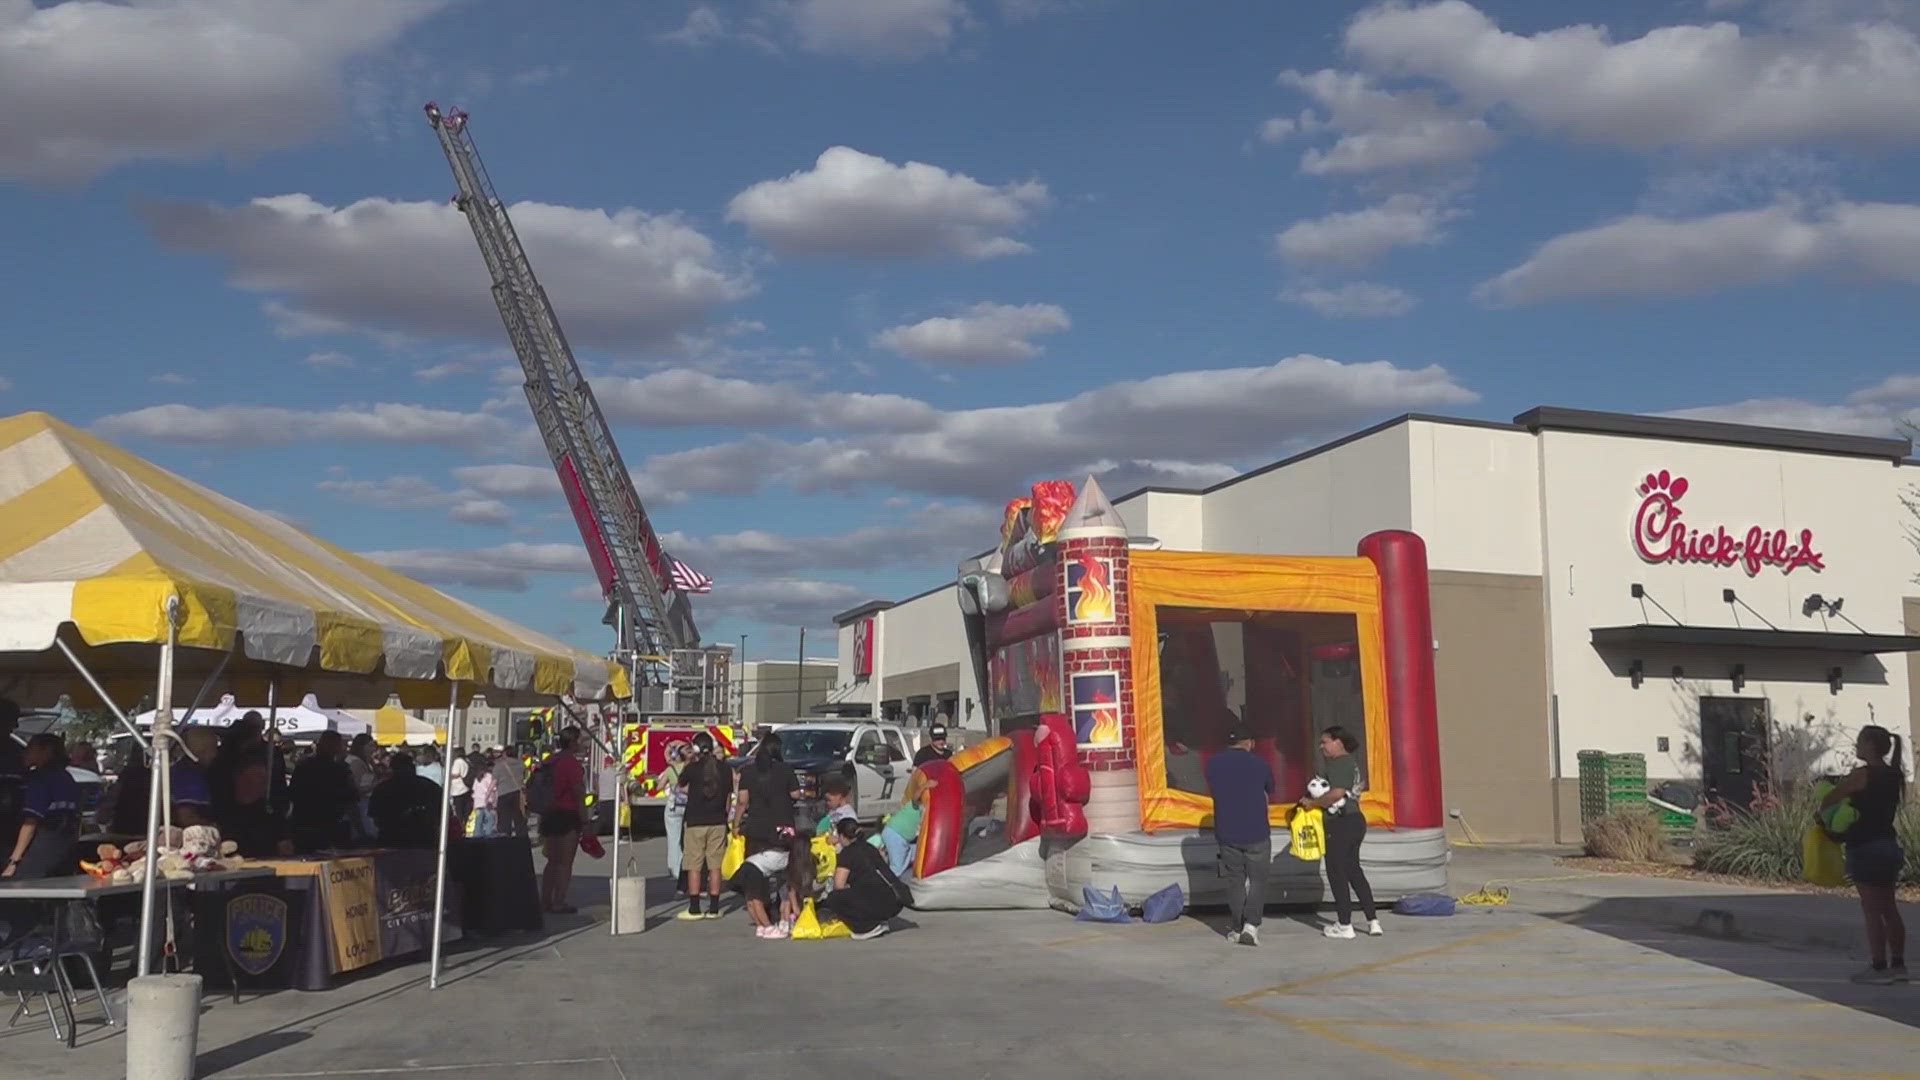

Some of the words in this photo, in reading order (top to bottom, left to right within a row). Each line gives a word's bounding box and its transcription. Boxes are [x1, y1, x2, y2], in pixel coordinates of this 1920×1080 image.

[1633, 471, 1826, 577] Chick-fil-A
[329, 864, 375, 885] COMMUNITY
[345, 939, 376, 959] LOYAT
